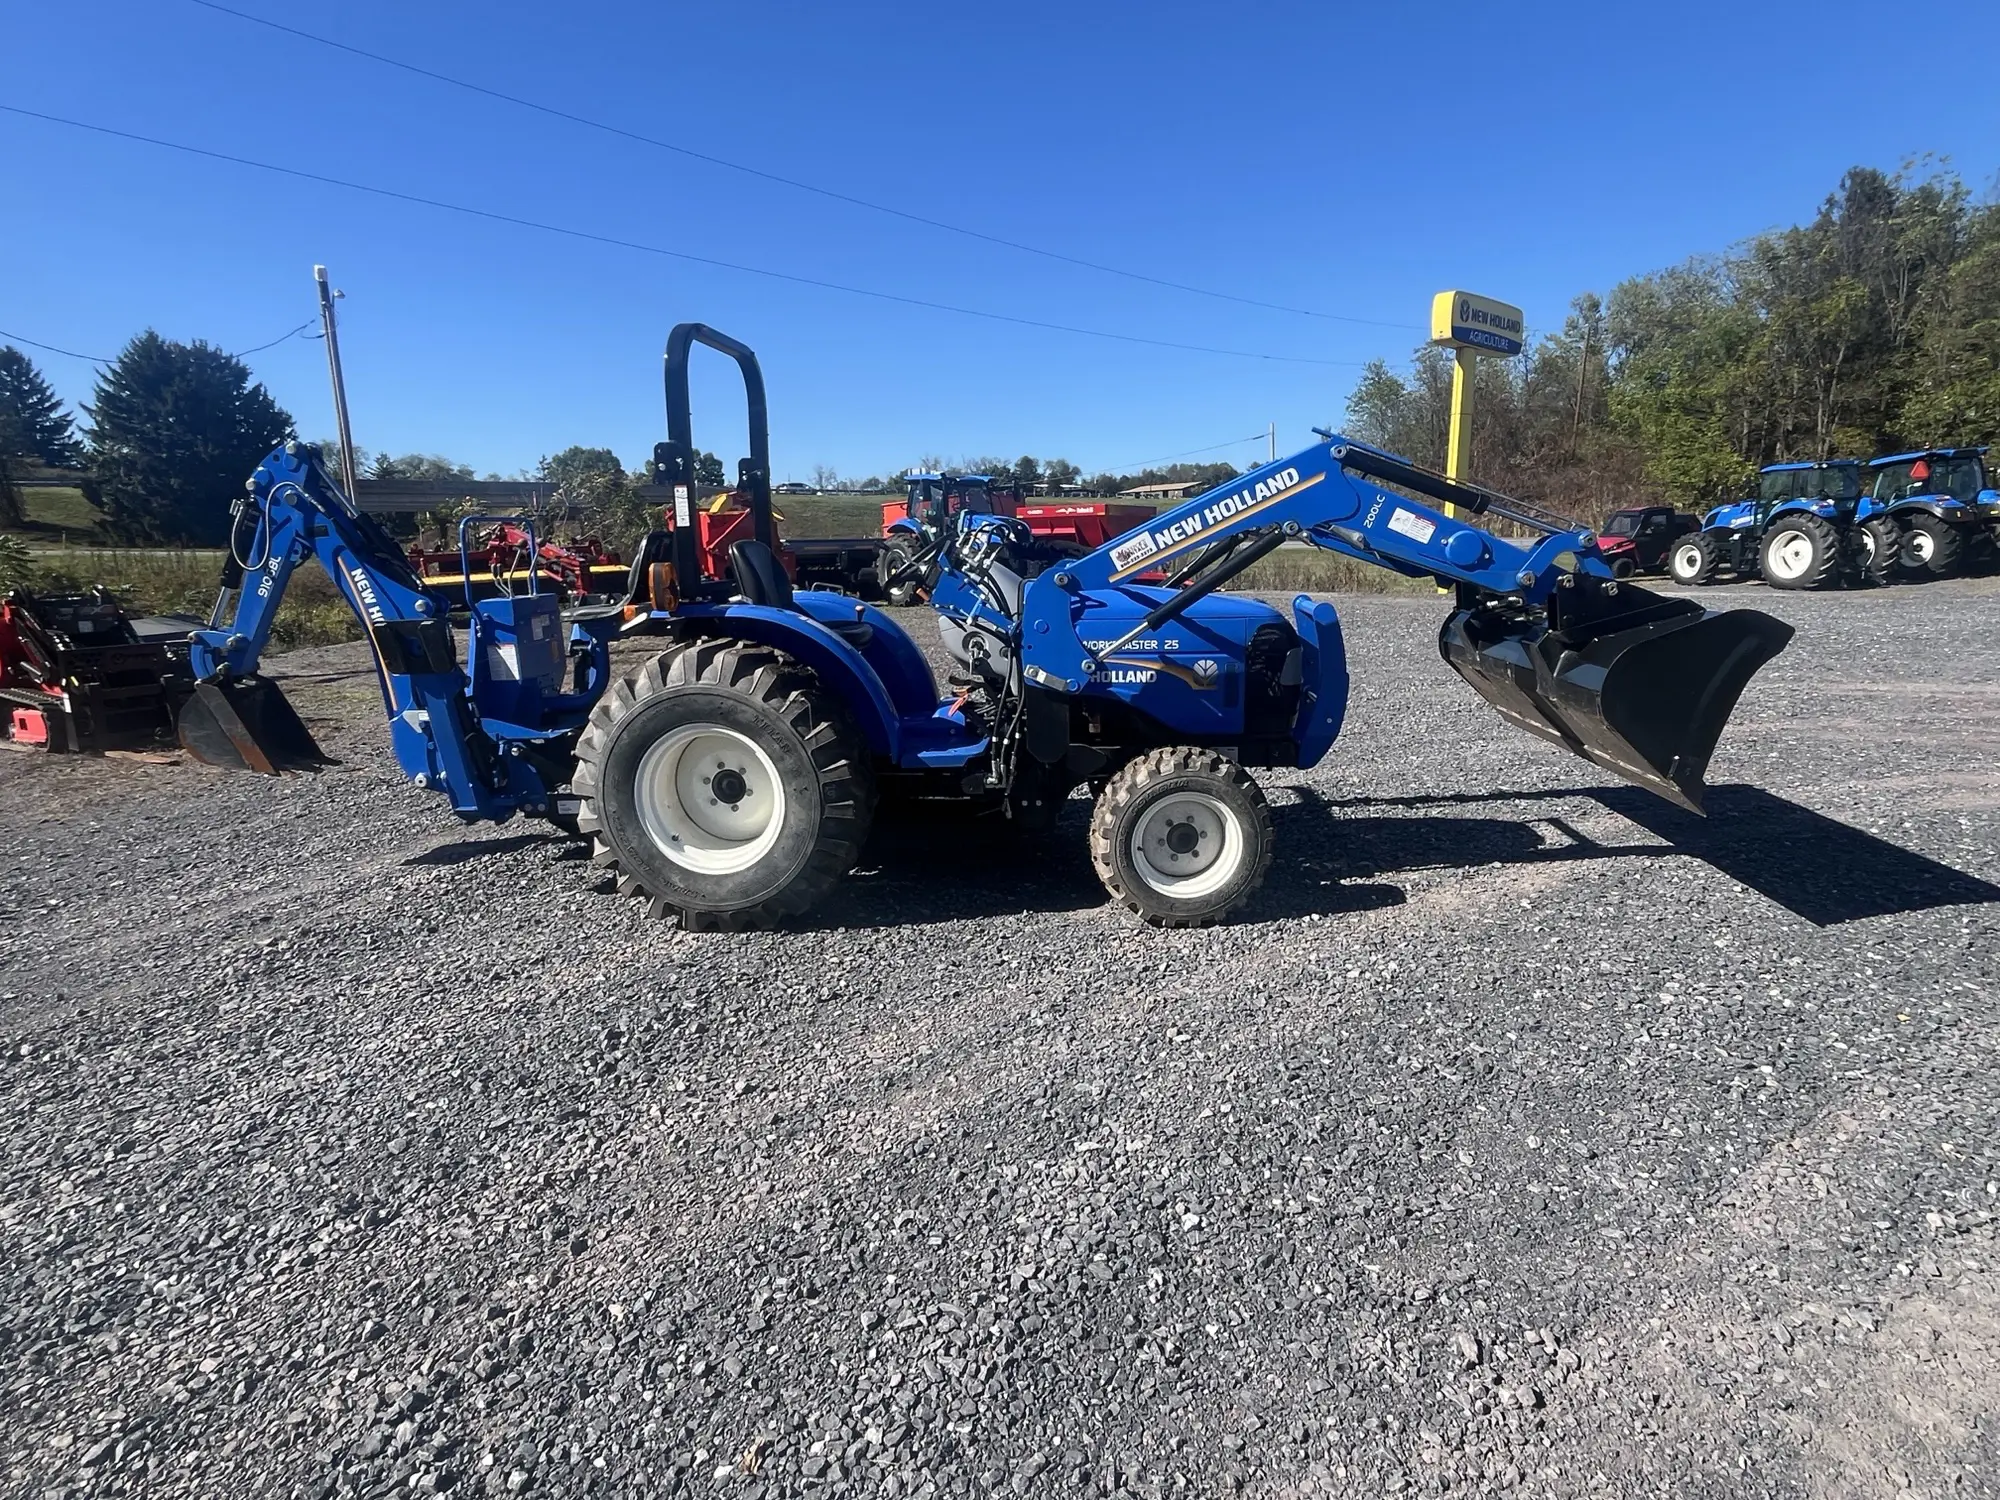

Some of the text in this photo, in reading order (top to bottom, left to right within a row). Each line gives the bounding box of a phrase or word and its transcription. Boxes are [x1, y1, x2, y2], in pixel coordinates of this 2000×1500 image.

[1471, 308, 1520, 333] NEW HOLLAND
[1469, 331, 1508, 349] AGRICULTURE
[1154, 467, 1300, 549] NEW HOLLAND
[1363, 494, 1386, 529] 200LC
[351, 567, 377, 604] NEW
[1082, 640, 1179, 650] WORKASTER 25
[1090, 670, 1158, 683] HOLLAND
